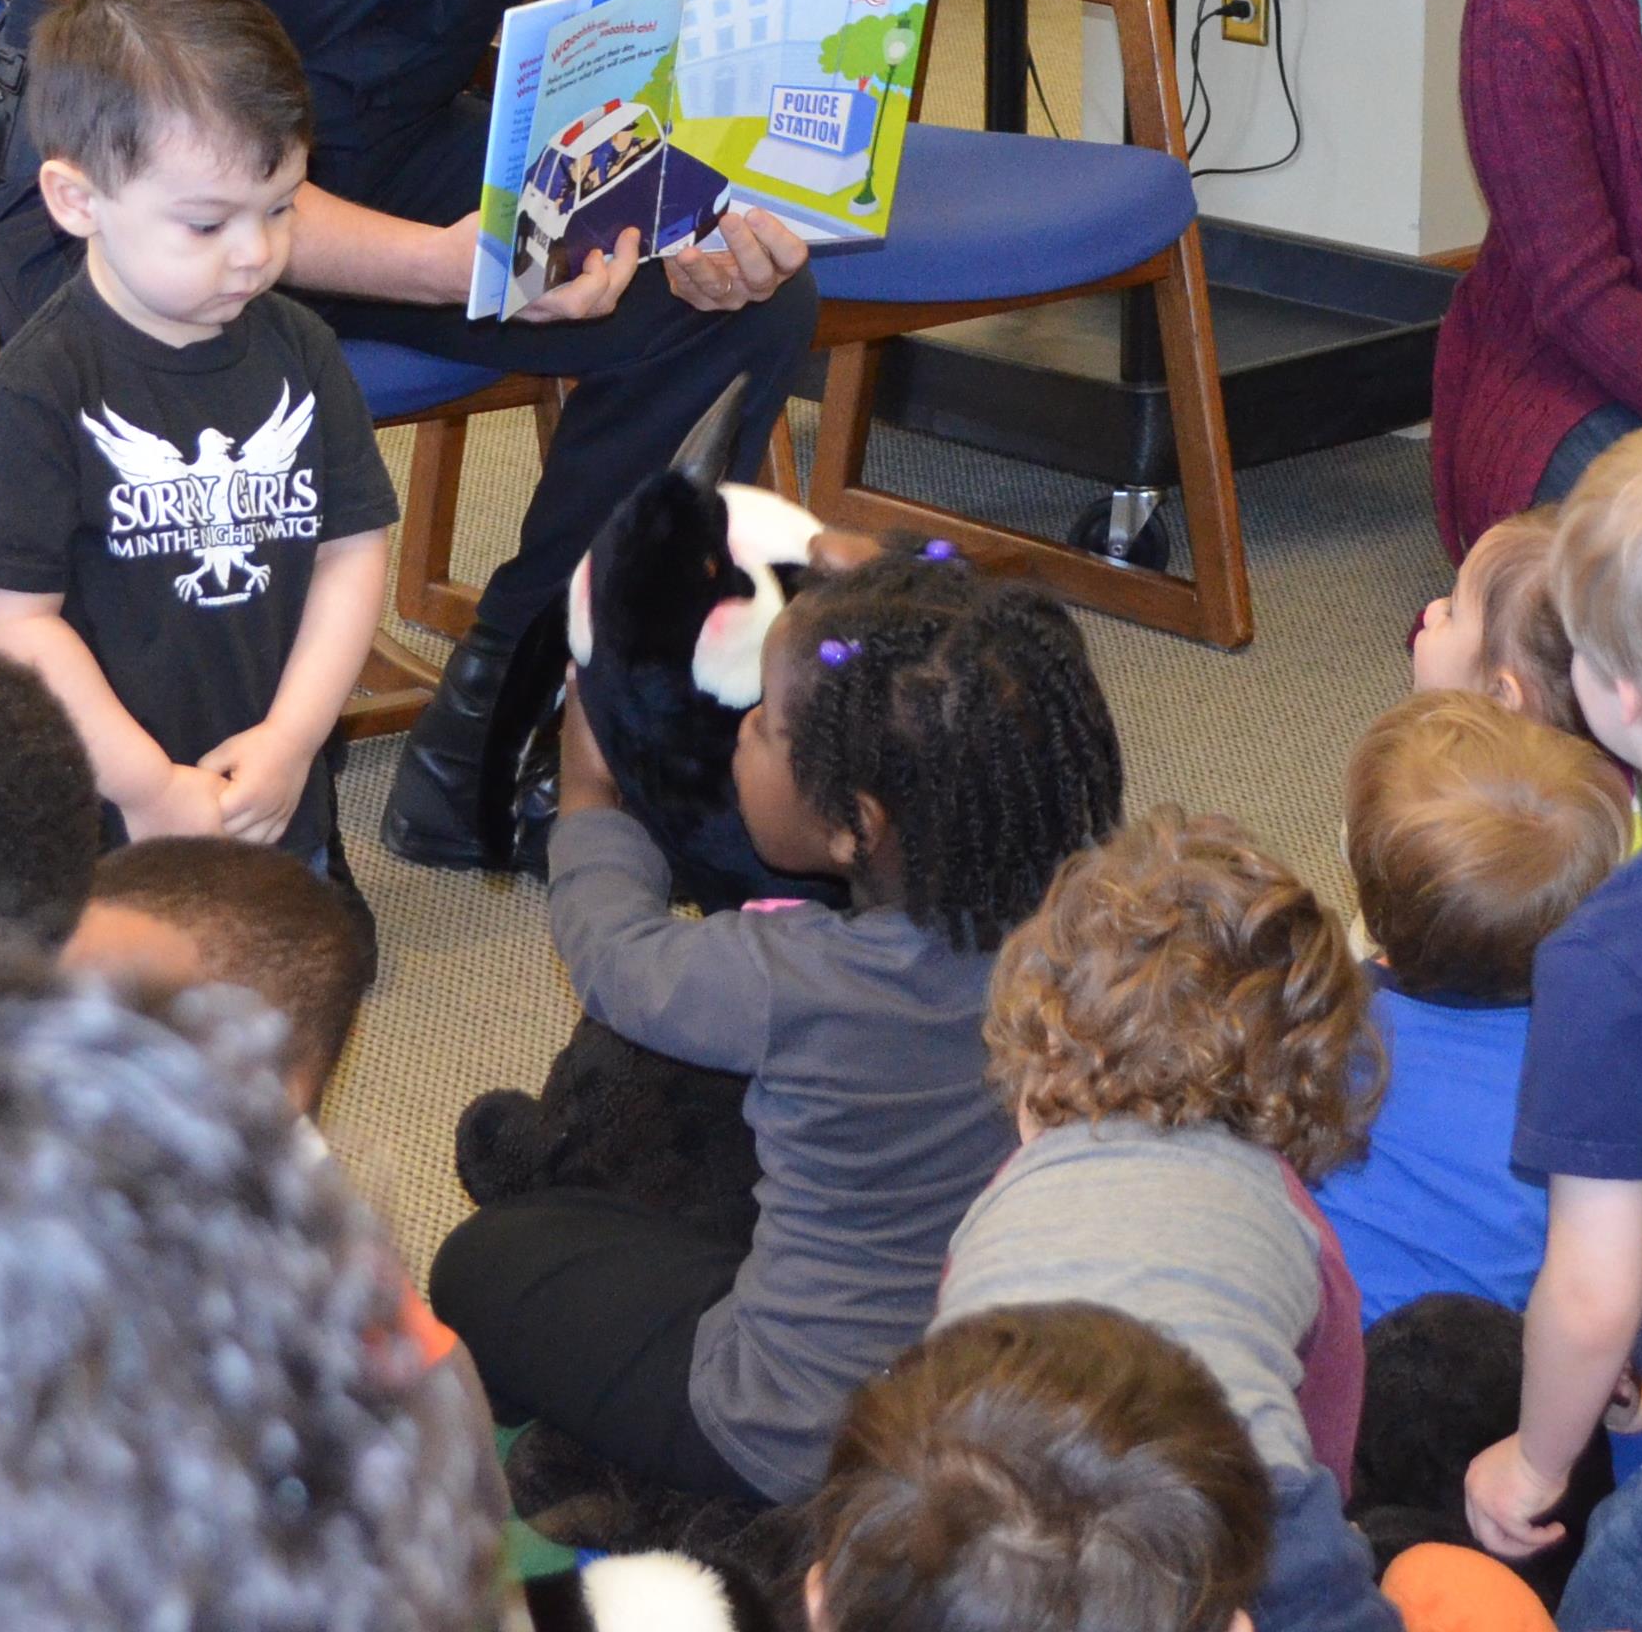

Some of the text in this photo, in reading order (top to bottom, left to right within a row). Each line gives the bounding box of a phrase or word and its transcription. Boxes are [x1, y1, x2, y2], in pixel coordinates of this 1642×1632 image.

[783, 92, 839, 118] POLICE
[773, 112, 841, 145] STATION
[109, 468, 318, 532] SORRY GIRLS
[159, 528, 200, 554] THE
